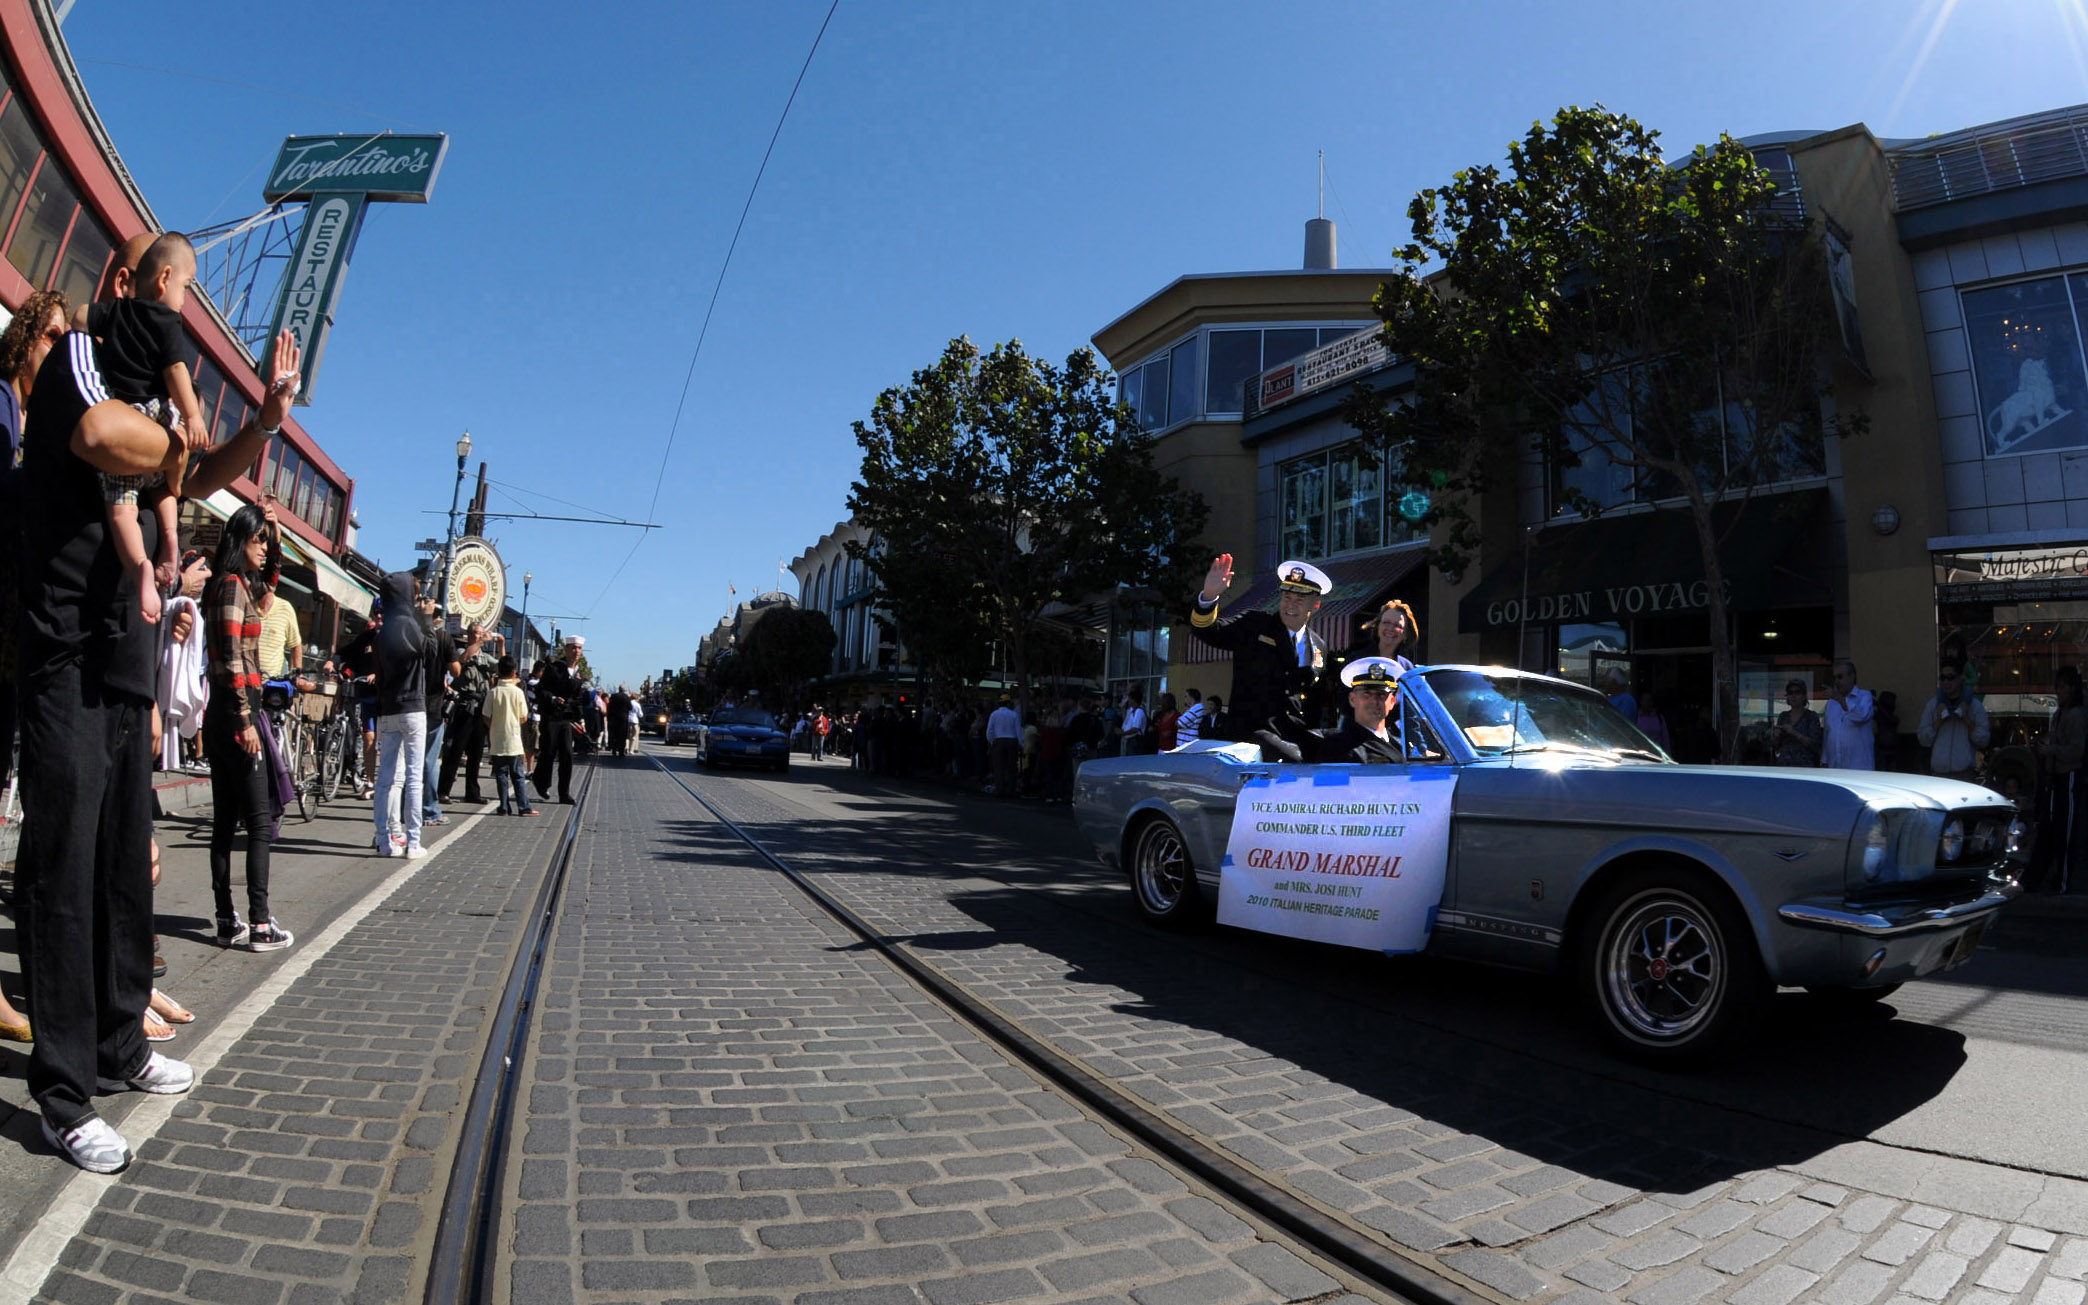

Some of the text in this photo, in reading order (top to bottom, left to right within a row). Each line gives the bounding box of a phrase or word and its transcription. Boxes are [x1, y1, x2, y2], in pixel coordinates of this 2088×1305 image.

[273, 140, 429, 188] Tarantino's
[289, 209, 342, 348] RESTAURA
[1297, 347, 1350, 374] RESTAURANT
[1353, 335, 1379, 351] SPAC
[484, 560, 499, 594] WHARF
[1979, 553, 2067, 581] Majestic
[1487, 592, 1592, 626] GOLDEN
[1251, 802, 1273, 813] VICE
[1273, 802, 1317, 814] ADMIRAL
[1319, 803, 1365, 815] RICHARD
[1400, 803, 1421, 815] USN
[1256, 821, 1405, 838] COMMANDER U.S. THIRD FLEET
[1247, 848, 1403, 879] GRAND MARSHAL
[1274, 880, 1363, 899] and MRS. JOSI HUNT
[1247, 894, 1380, 921] 2010 ITALIAN HERITAGE PARADE
[1469, 919, 1541, 936] MUSTANG
